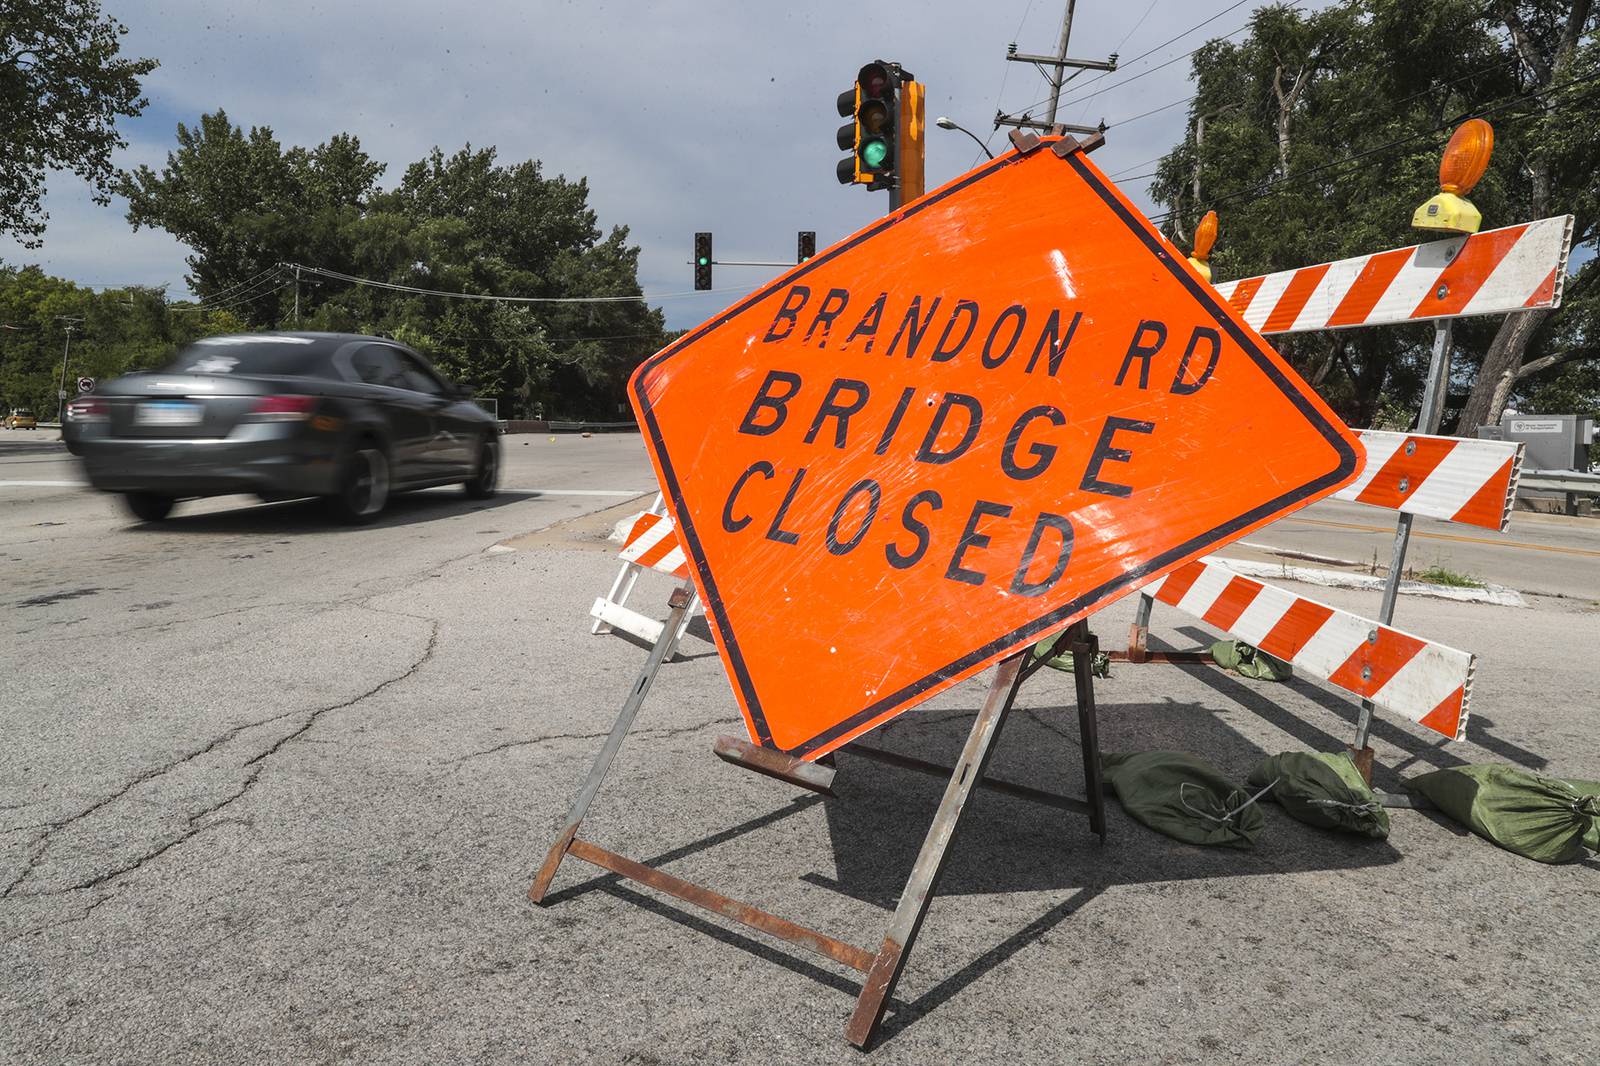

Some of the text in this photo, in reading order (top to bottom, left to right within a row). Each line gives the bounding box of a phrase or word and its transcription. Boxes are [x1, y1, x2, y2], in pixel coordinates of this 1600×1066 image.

[762, 285, 1222, 396] BRANDON RD
[738, 369, 1156, 498] BRIDGE
[721, 460, 1076, 598] CLOSED
